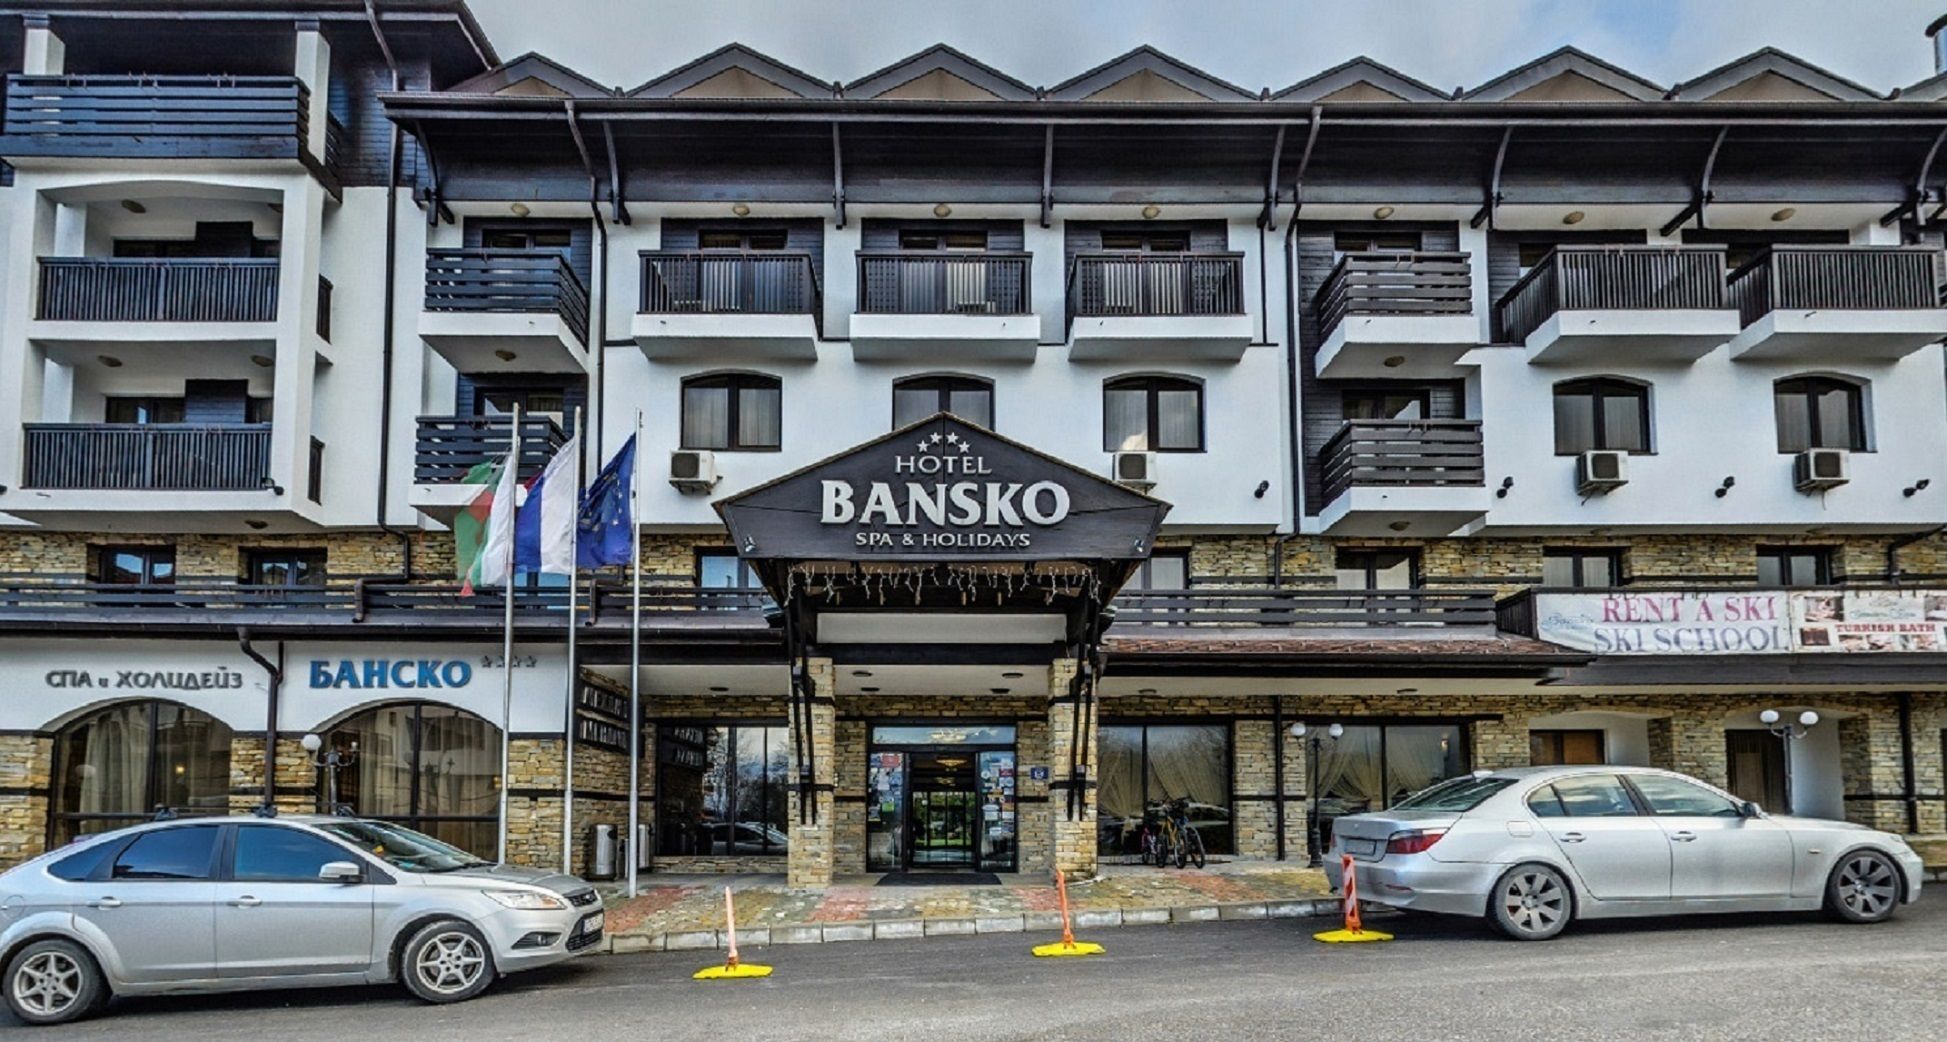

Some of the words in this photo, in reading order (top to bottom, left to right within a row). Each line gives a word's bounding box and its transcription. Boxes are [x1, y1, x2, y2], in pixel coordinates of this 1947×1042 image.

[895, 456, 992, 475] HOTEL
[820, 479, 1070, 527] BANSKO
[855, 532, 894, 547] SPA
[901, 532, 915, 546] &
[922, 532, 1031, 548] HOLIDAYS
[1602, 597, 1682, 623] RENT
[1695, 599, 1714, 621] A
[1724, 597, 1778, 621] SKI
[1594, 627, 1642, 651] SKI
[1653, 626, 1789, 651] SCHOOL
[1835, 623, 1896, 633] TURKISH
[1900, 623, 1936, 633] BATH
[45, 669, 92, 688] СПА
[309, 660, 472, 689] БАНСКО
